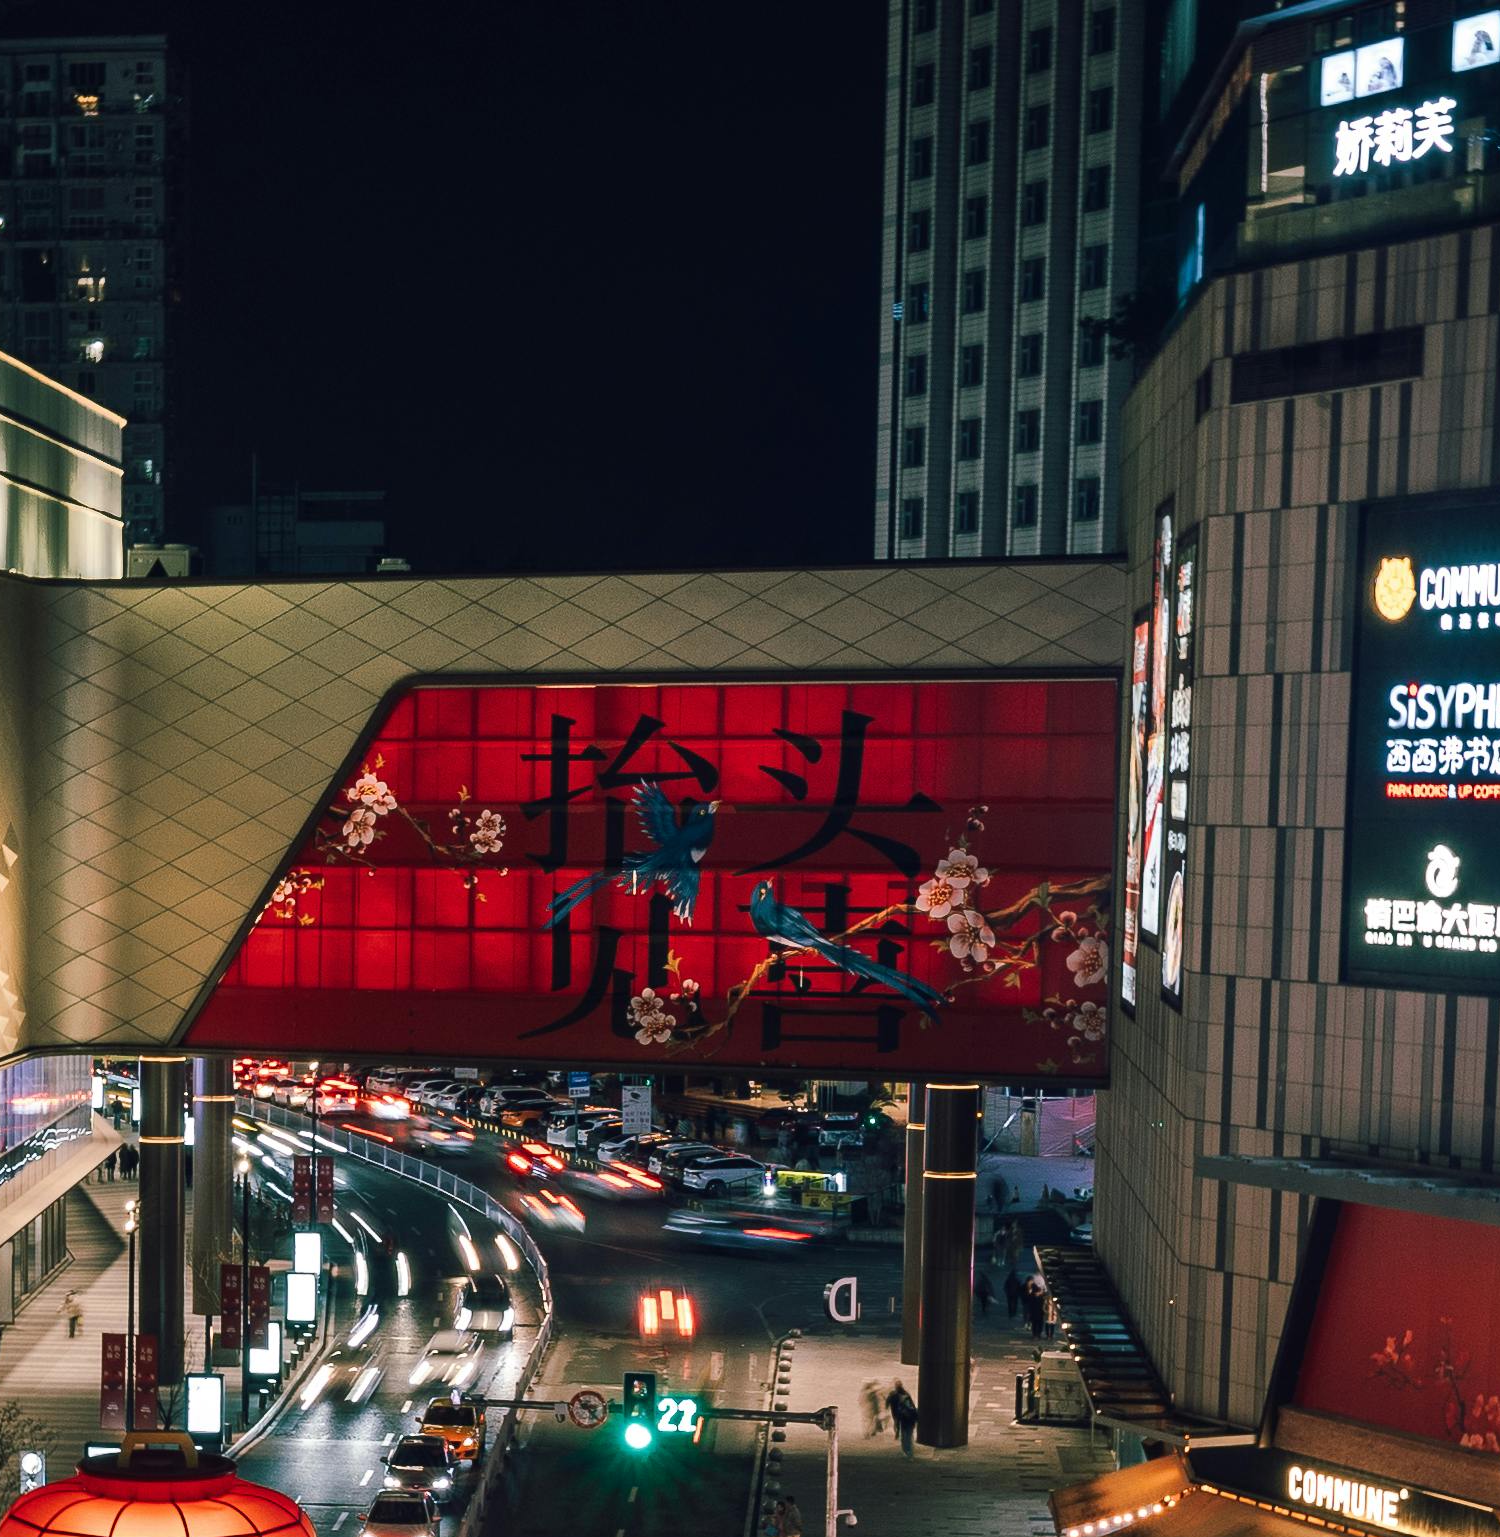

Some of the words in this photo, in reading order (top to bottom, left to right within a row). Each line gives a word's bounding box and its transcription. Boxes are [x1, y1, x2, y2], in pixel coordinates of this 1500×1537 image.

[1333, 97, 1457, 177] 娇莉芙
[520, 710, 944, 879] 抬头
[1414, 783, 1448, 798] BOOKS
[1458, 784, 1473, 799] UP
[1365, 931, 1393, 946] QIAO
[1287, 1466, 1399, 1527] COMMUNE
